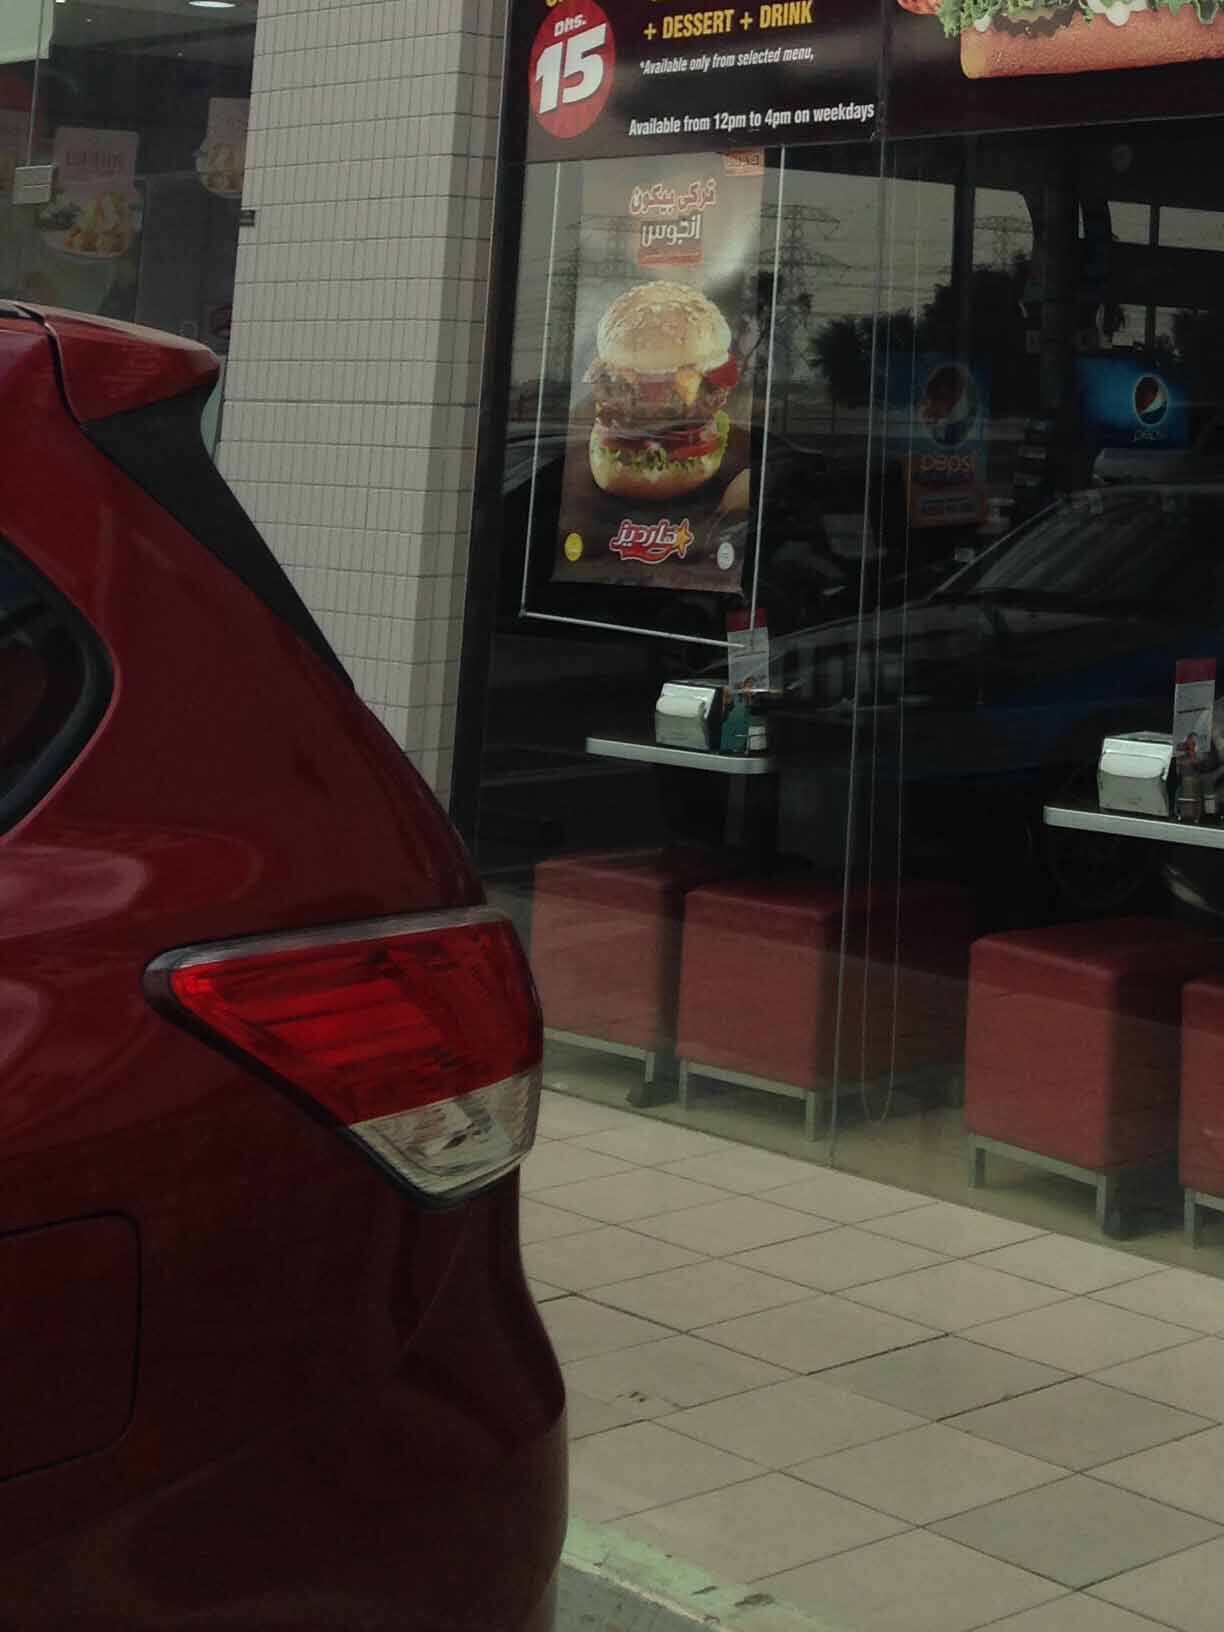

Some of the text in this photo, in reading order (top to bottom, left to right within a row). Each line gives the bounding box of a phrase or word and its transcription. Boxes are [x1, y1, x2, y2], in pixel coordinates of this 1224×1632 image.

[644, 0, 814, 40] + DESSERT + DRINK
[535, 24, 607, 114] 15
[688, 54, 709, 73] only
[712, 53, 735, 69] from
[737, 48, 780, 66] selected
[628, 102, 875, 137] Available from 12pm to 4pm on weekdays
